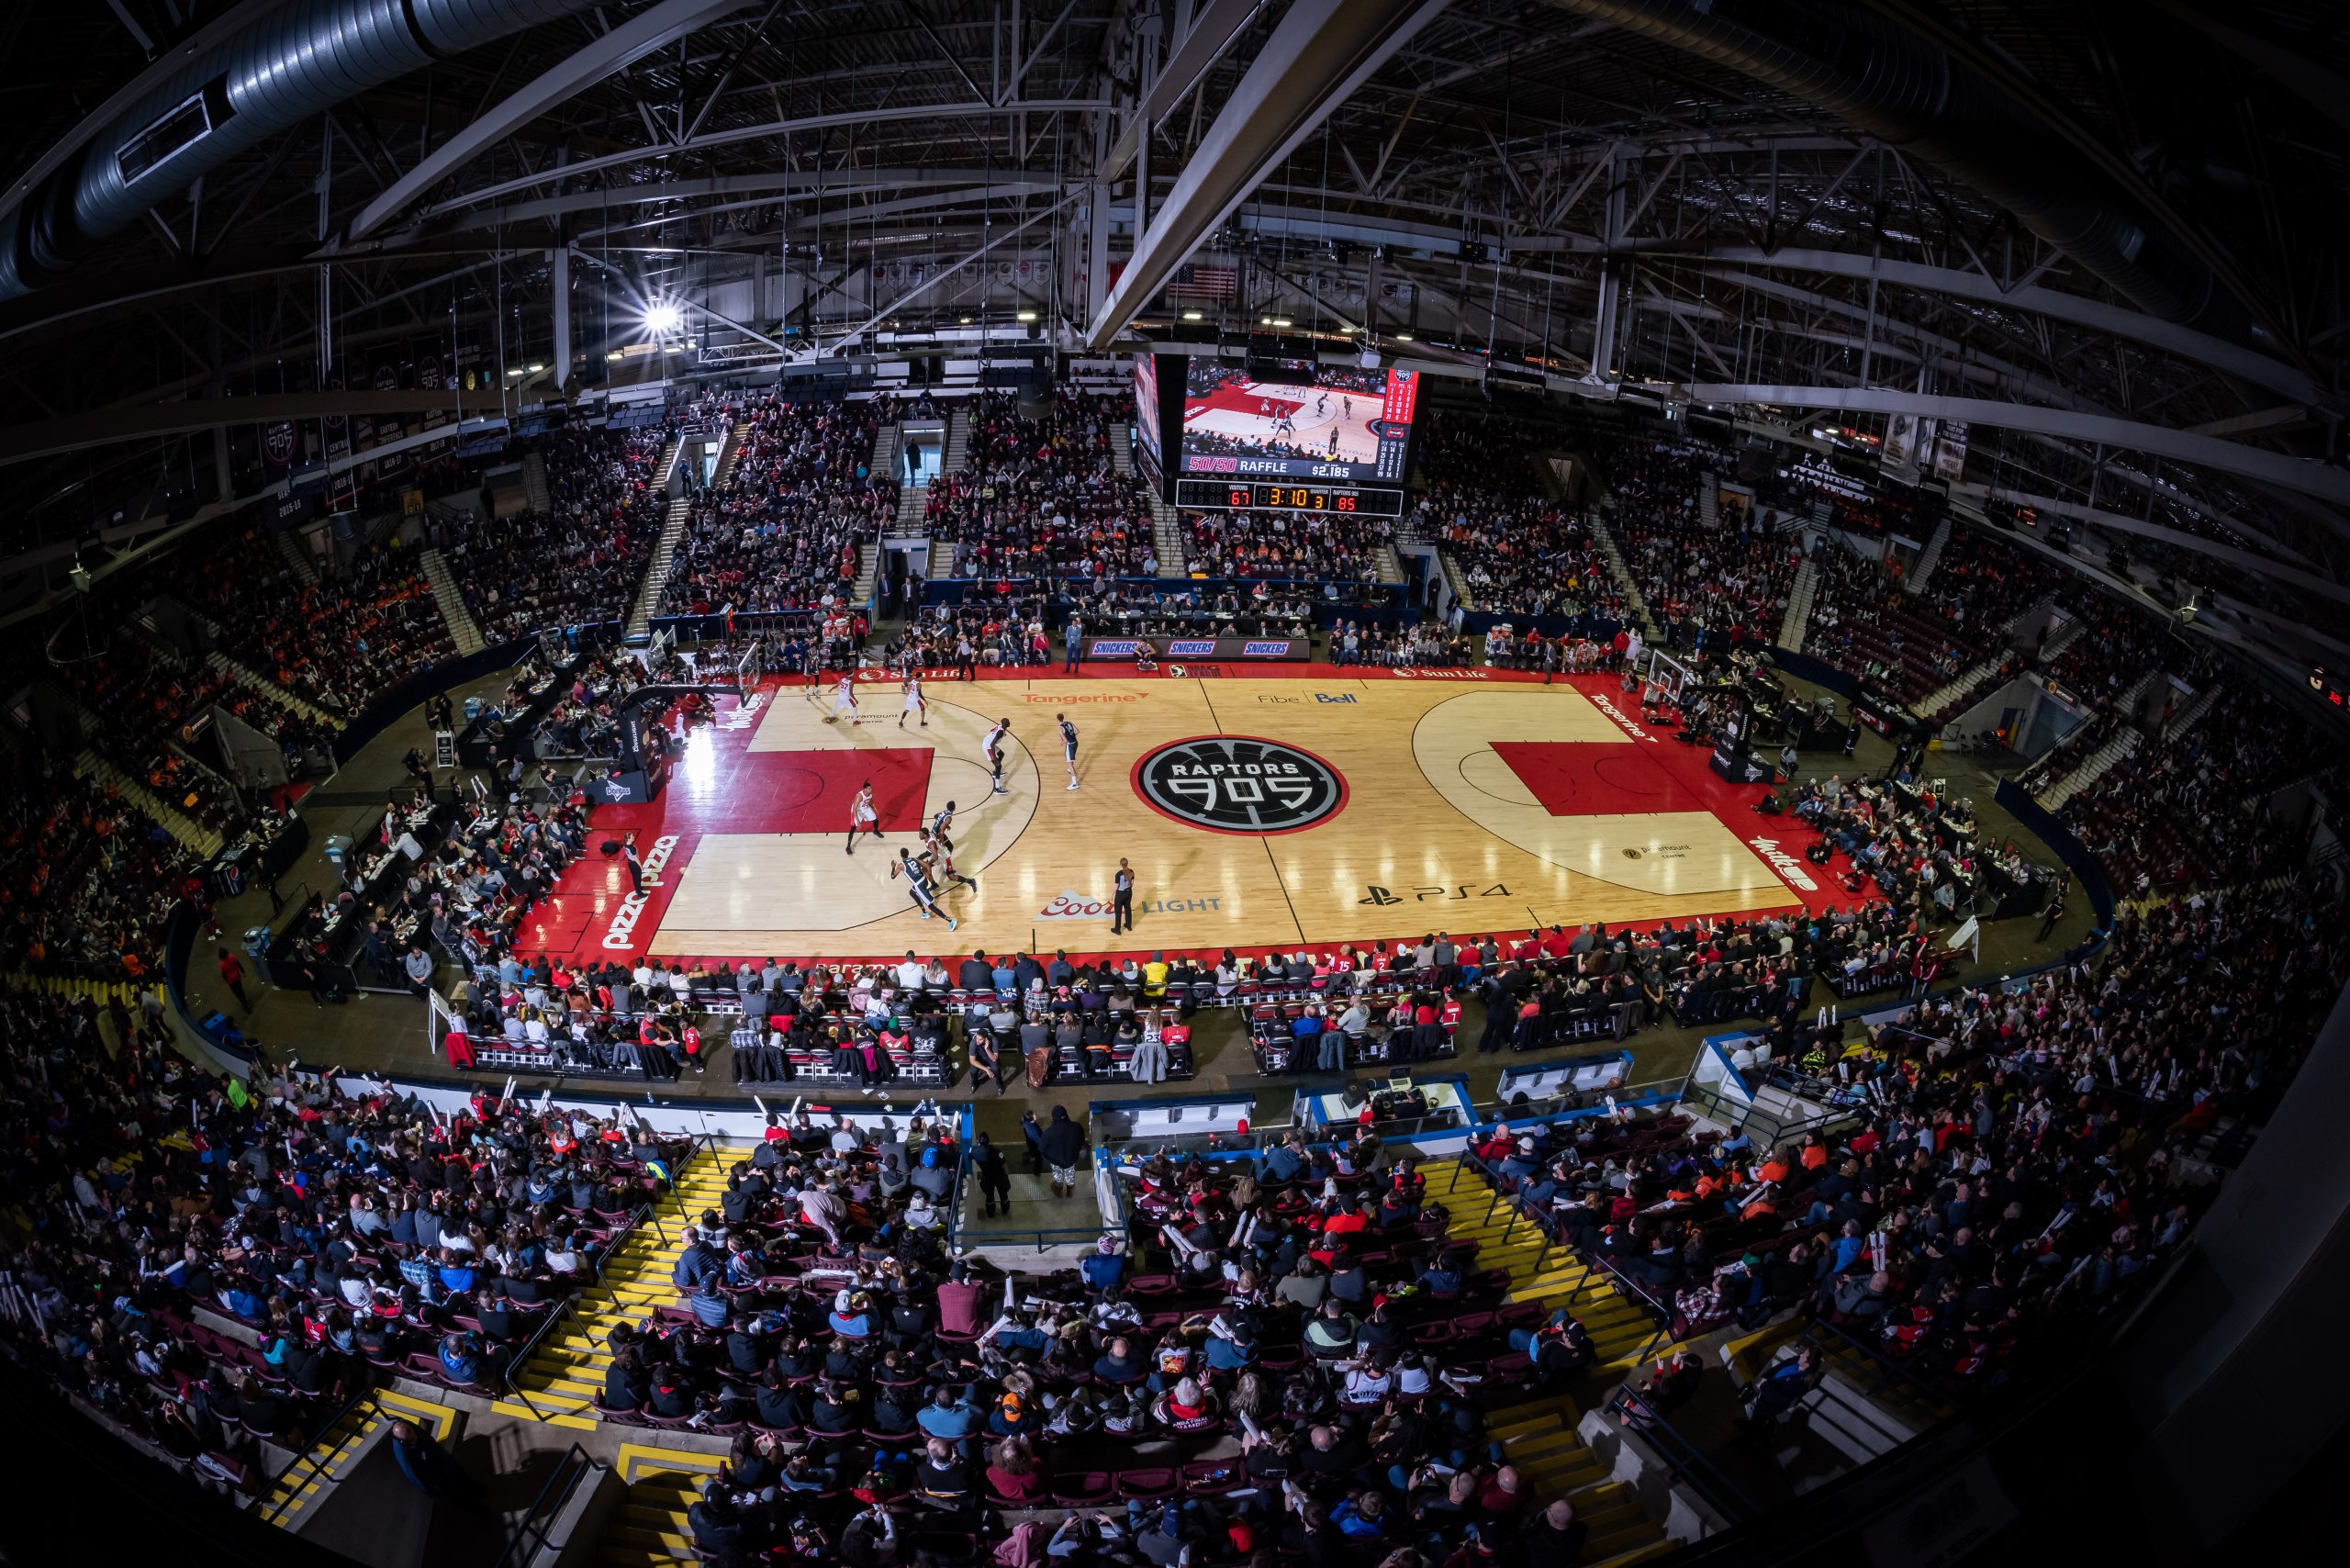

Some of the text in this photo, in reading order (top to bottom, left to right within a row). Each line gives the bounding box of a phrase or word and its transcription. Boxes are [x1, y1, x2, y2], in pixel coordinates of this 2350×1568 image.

[268, 430, 292, 454] 905
[330, 441, 349, 453] CENTRA
[1189, 457, 1287, 472] 50/50 RAFFLE
[334, 475, 352, 490] 2016-1
[1232, 492, 1248, 505] 67
[1270, 488, 1306, 505] 3:10
[1315, 496, 1323, 509] 3
[279, 499, 301, 518] 2015-16
[1338, 498, 1355, 510] 85
[1094, 643, 1136, 654] SNICKERS
[1171, 643, 1214, 654] SNICKERS
[1245, 643, 1289, 655] SNICKERS
[1421, 669, 1488, 678] Sun Life
[1021, 693, 1136, 705] Tangerine
[1315, 694, 1357, 703] Bell
[1590, 694, 1645, 736] Tangerine
[1172, 763, 1299, 776] RAPTORS
[1168, 778, 1313, 812] 905
[641, 835, 679, 886] pizza
[908, 861, 918, 871] 12
[1413, 883, 1513, 902] PS4
[1041, 897, 1221, 916] Coor LIGHT
[1340, 961, 1349, 971] 15
[1380, 962, 1384, 970] 2
[1452, 1014, 1456, 1022] 7
[1147, 1035, 1159, 1043] 23
